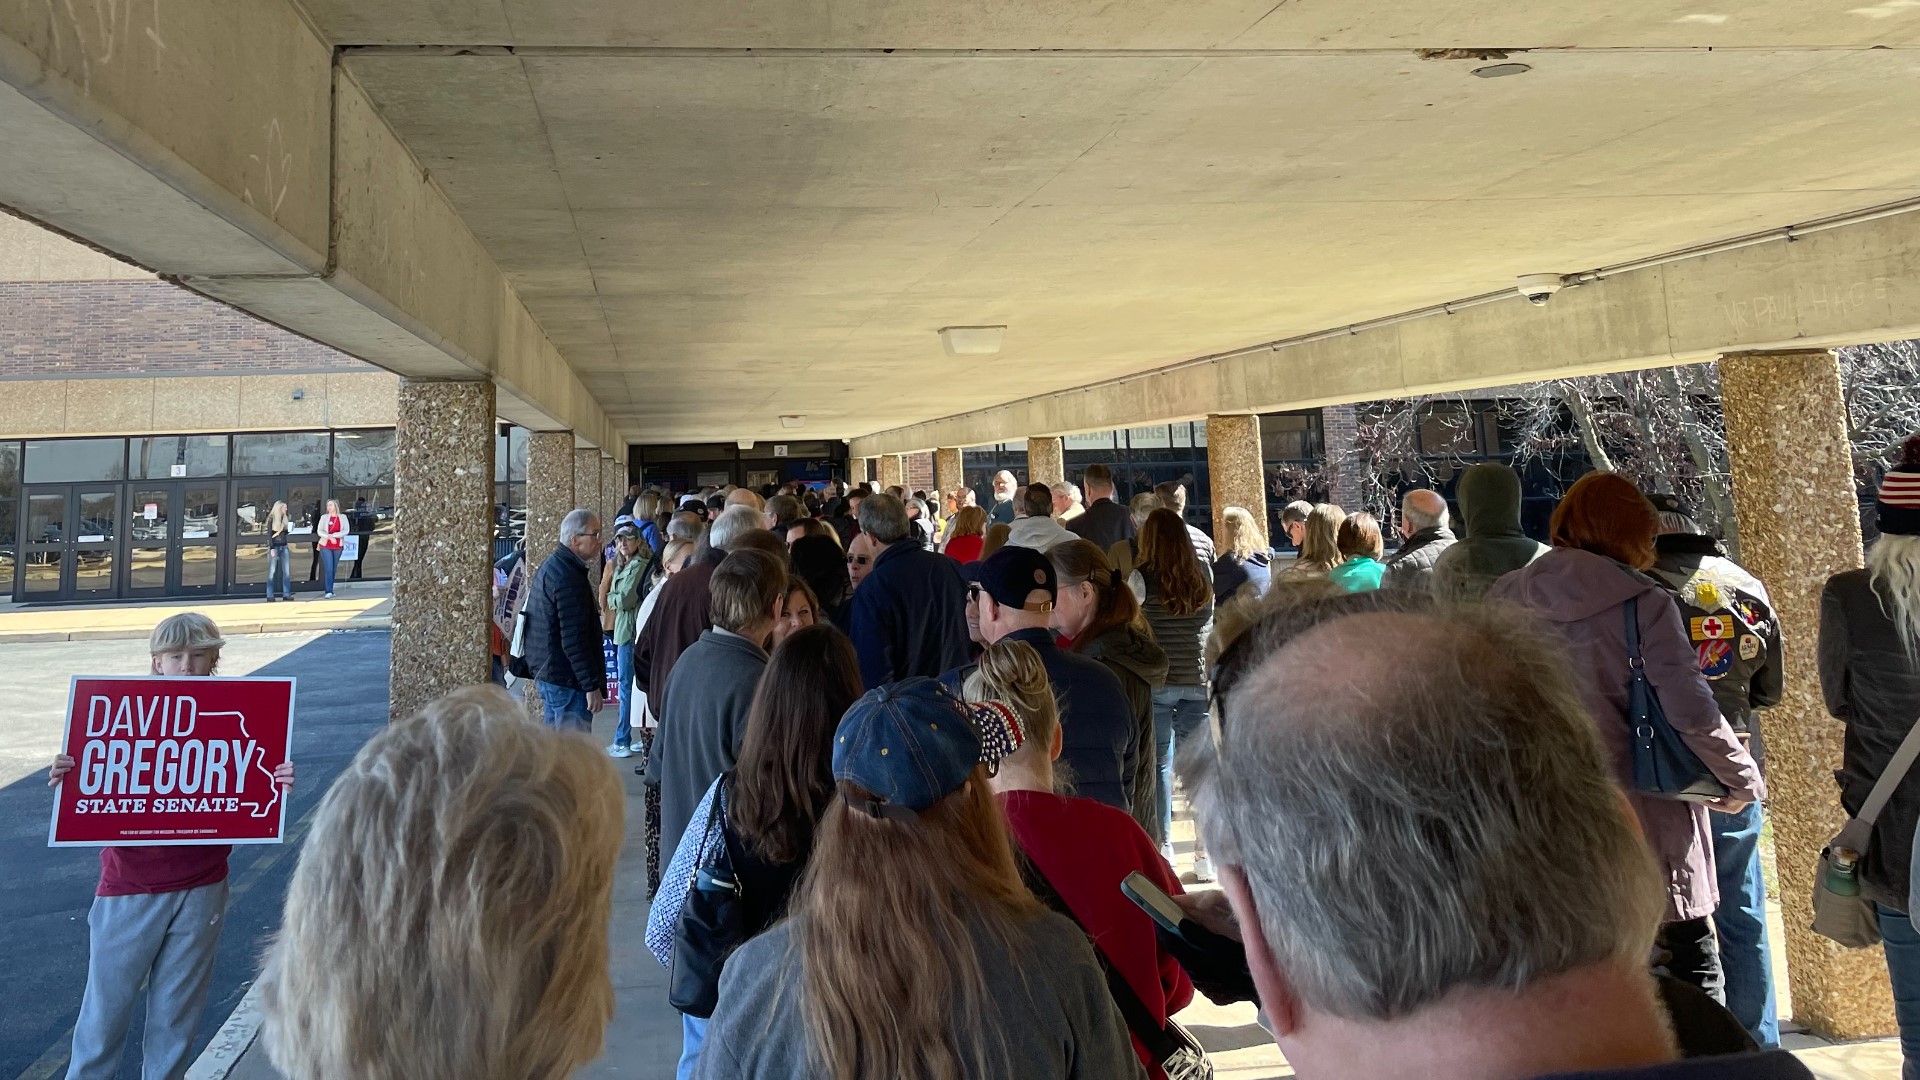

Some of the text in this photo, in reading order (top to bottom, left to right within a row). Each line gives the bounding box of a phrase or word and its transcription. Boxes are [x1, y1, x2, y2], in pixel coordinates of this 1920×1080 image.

[86, 695, 197, 737] DAVID
[79, 739, 256, 794] GREGORY
[75, 798, 239, 814] STATE SENATE
